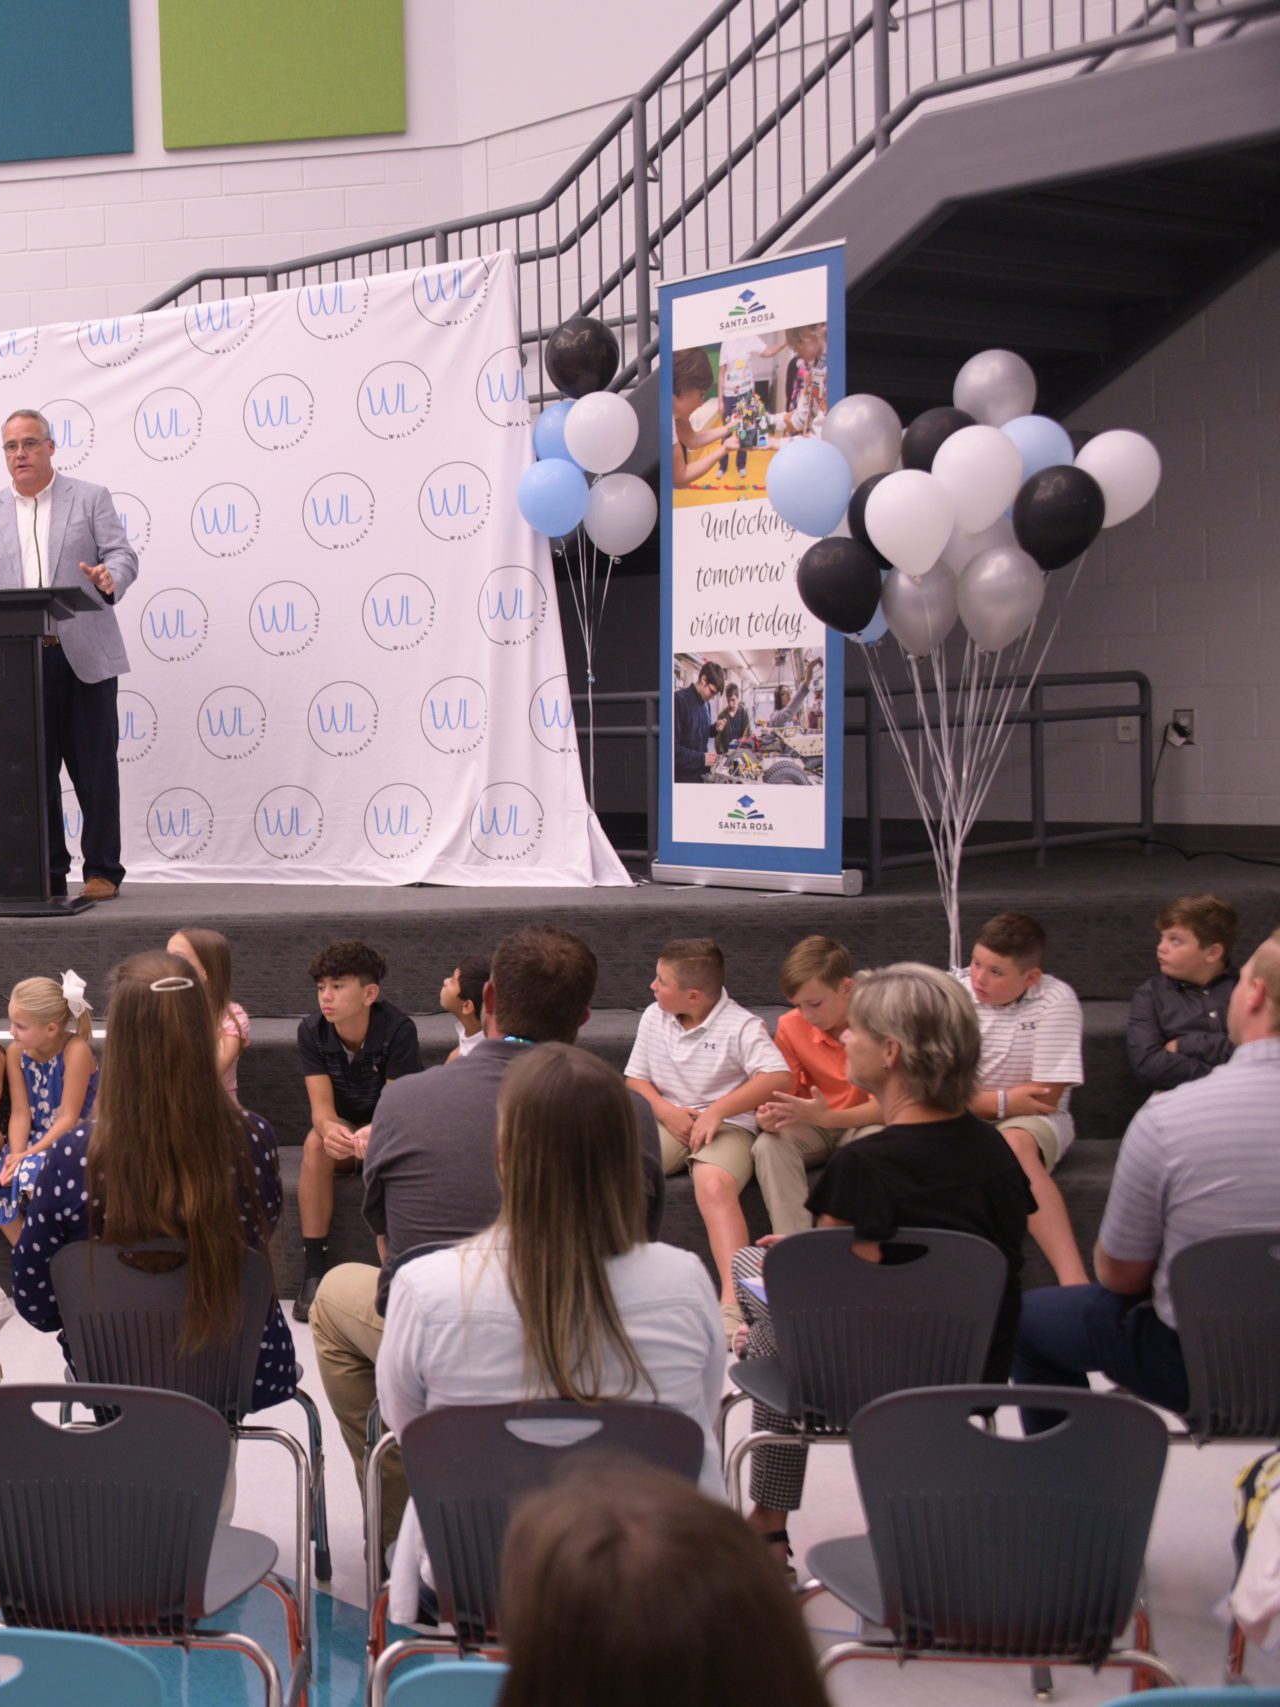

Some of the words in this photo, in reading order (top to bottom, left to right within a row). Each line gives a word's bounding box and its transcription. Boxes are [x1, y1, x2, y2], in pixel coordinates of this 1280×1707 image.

[307, 284, 356, 316] WL
[423, 268, 476, 303] WL
[195, 301, 243, 332] WL
[720, 318, 748, 330] SANTA
[751, 312, 775, 323] ROSA
[88, 319, 132, 346] WL
[252, 395, 302, 427] WL
[367, 383, 419, 416] WL
[143, 408, 190, 439] WL
[507, 419, 532, 428] WALL
[312, 494, 362, 526] WL
[428, 484, 480, 516] WL
[200, 504, 248, 535] WL
[258, 602, 307, 633] WL
[372, 595, 422, 627] WL
[486, 588, 534, 621] WL
[149, 609, 197, 639] WL
[690, 612, 740, 637] vision
[747, 604, 807, 642] today.
[206, 707, 254, 737] WL
[317, 702, 366, 733] WL
[430, 698, 479, 730] WL
[540, 697, 574, 729] W
[156, 808, 201, 837] WL
[264, 806, 311, 836] WL
[374, 805, 419, 836] WL
[480, 804, 530, 836] WL
[718, 821, 747, 830] SANTA
[749, 822, 774, 831] ROSA
